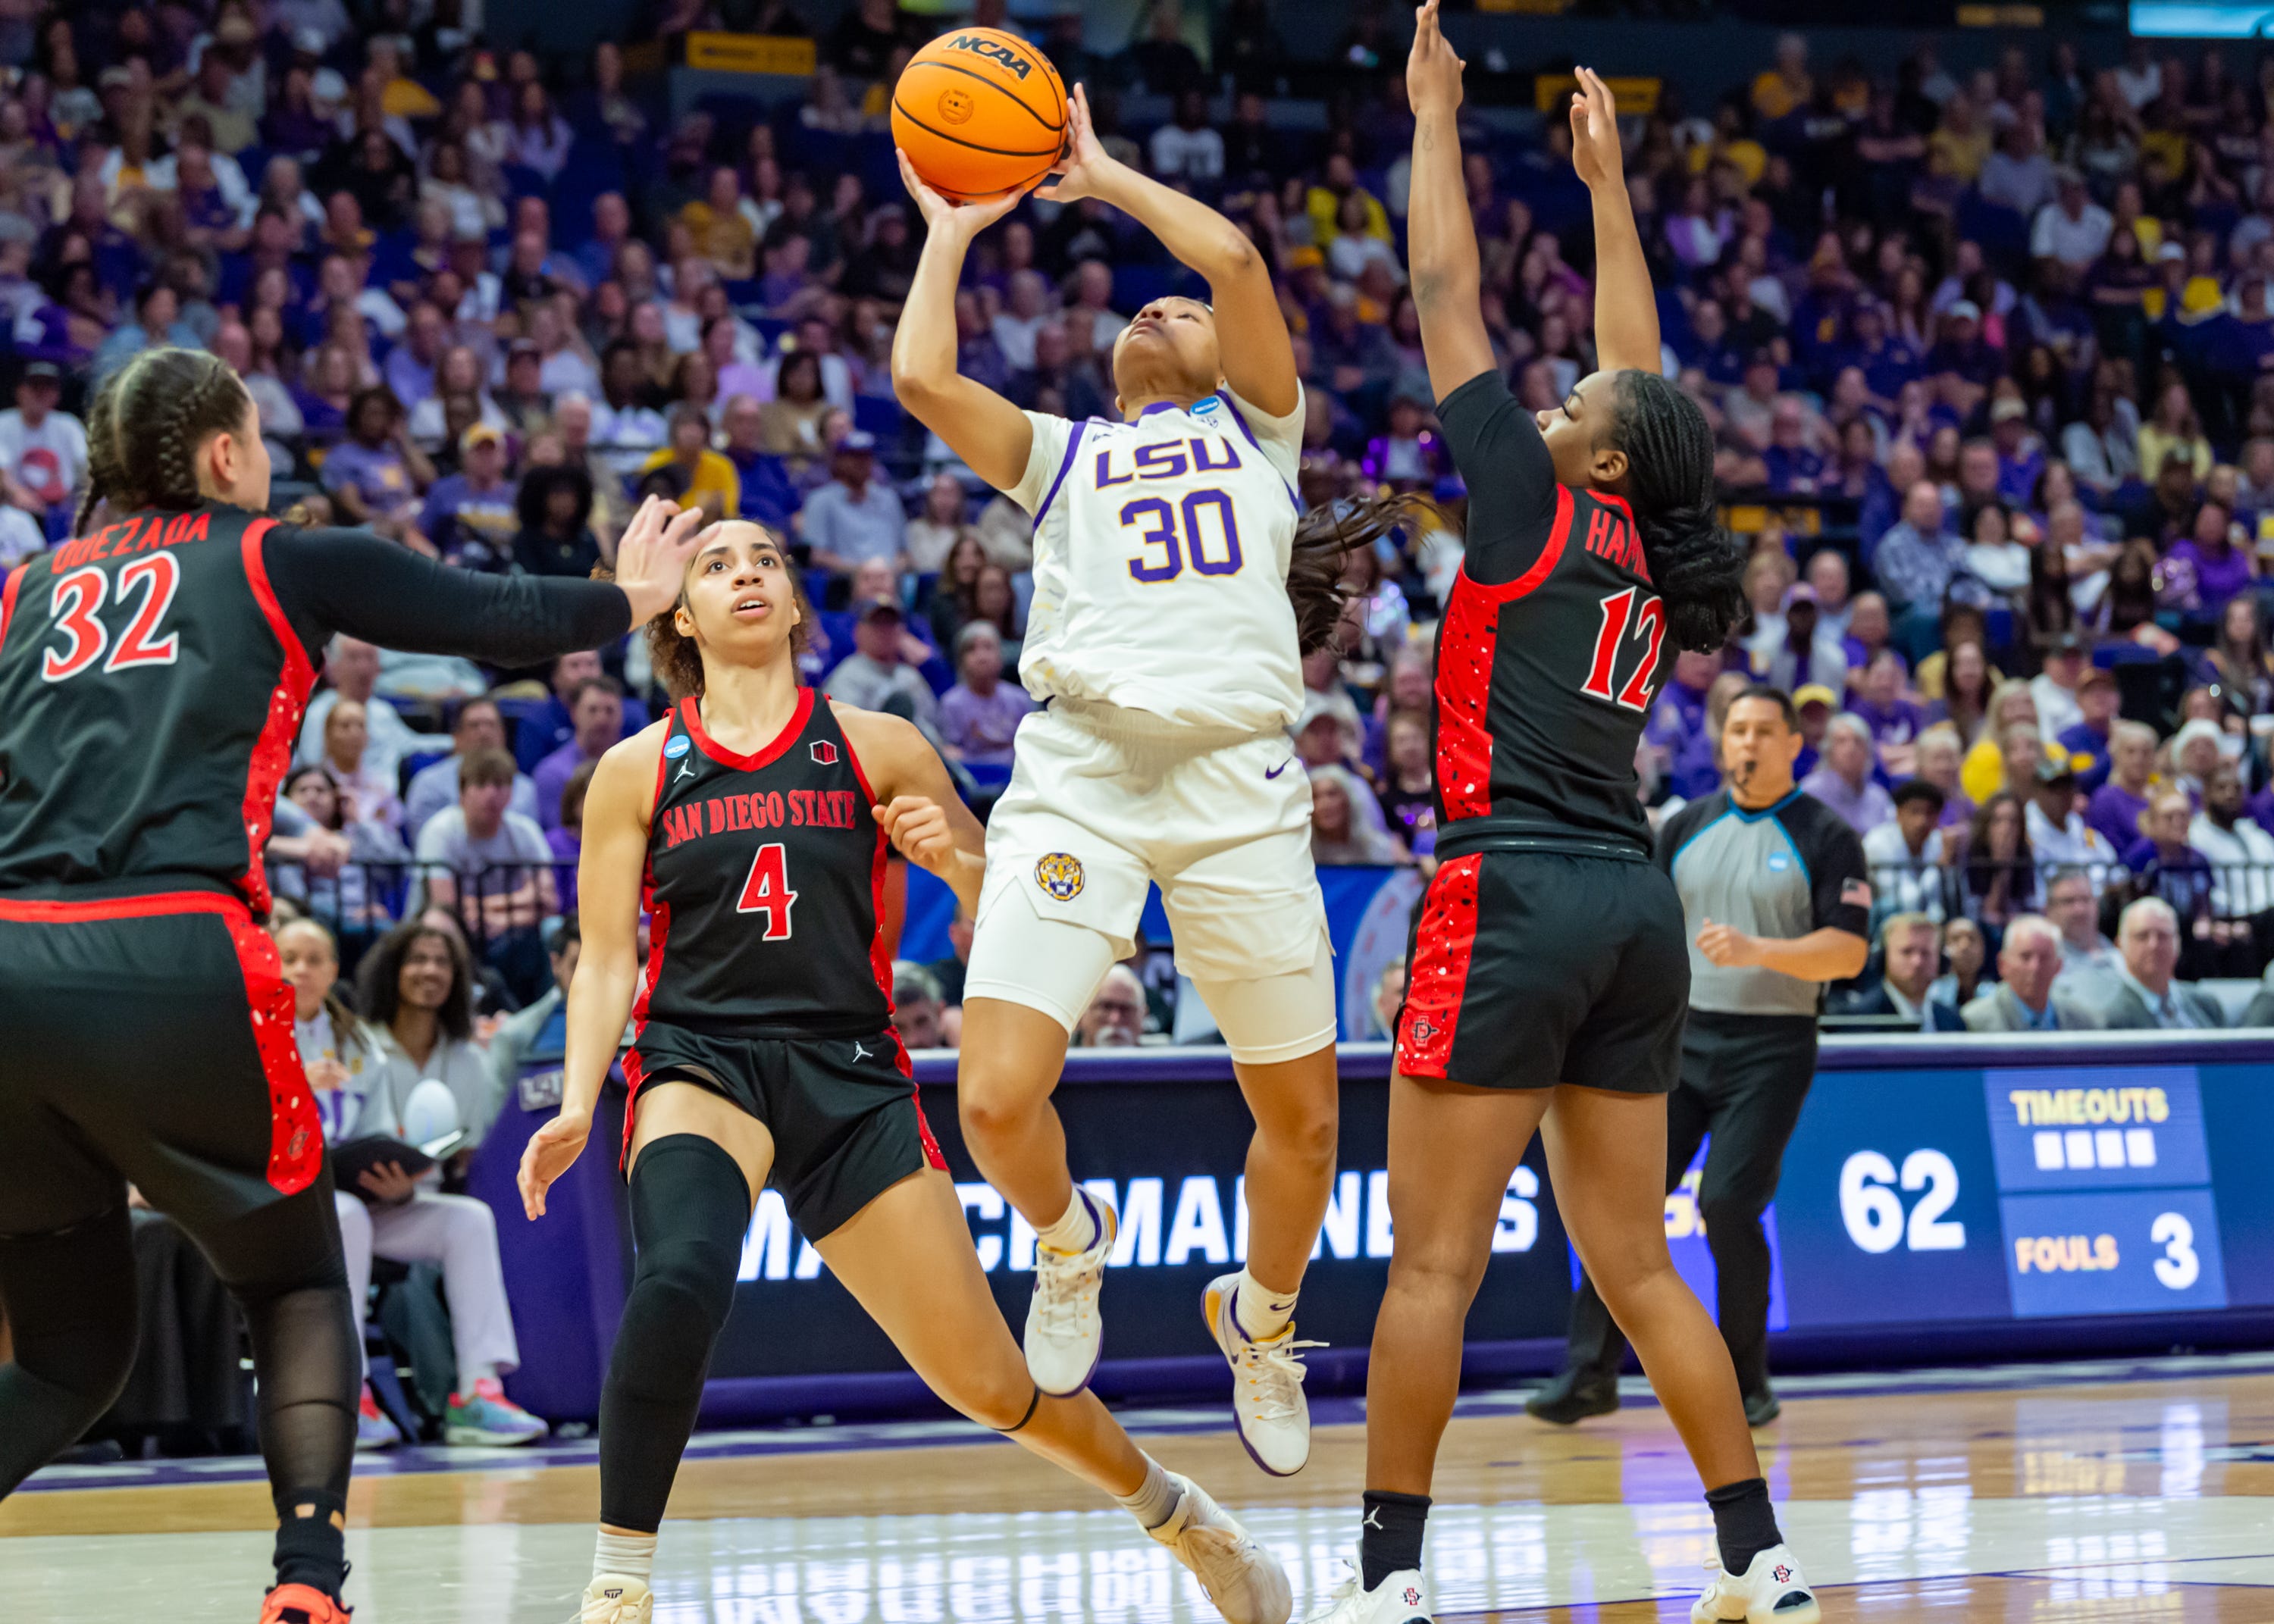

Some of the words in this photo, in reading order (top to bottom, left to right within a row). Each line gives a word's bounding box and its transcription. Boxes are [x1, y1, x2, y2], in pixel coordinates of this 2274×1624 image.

[946, 35, 1032, 80] NCAA
[1095, 435, 1242, 491] LSU
[1118, 488, 1244, 585] 30
[41, 549, 180, 683] 32
[1580, 585, 1668, 712] 12
[662, 802, 703, 849] SAN
[706, 791, 785, 834] DIEGO
[788, 789, 856, 830] STATE
[736, 843, 799, 941] 4
[2009, 1087, 2169, 1126] TIMEOUTS
[1839, 1148, 1966, 1254] 62
[2015, 1234, 2120, 1274] FOULS
[2150, 1212, 2200, 1290] 3
